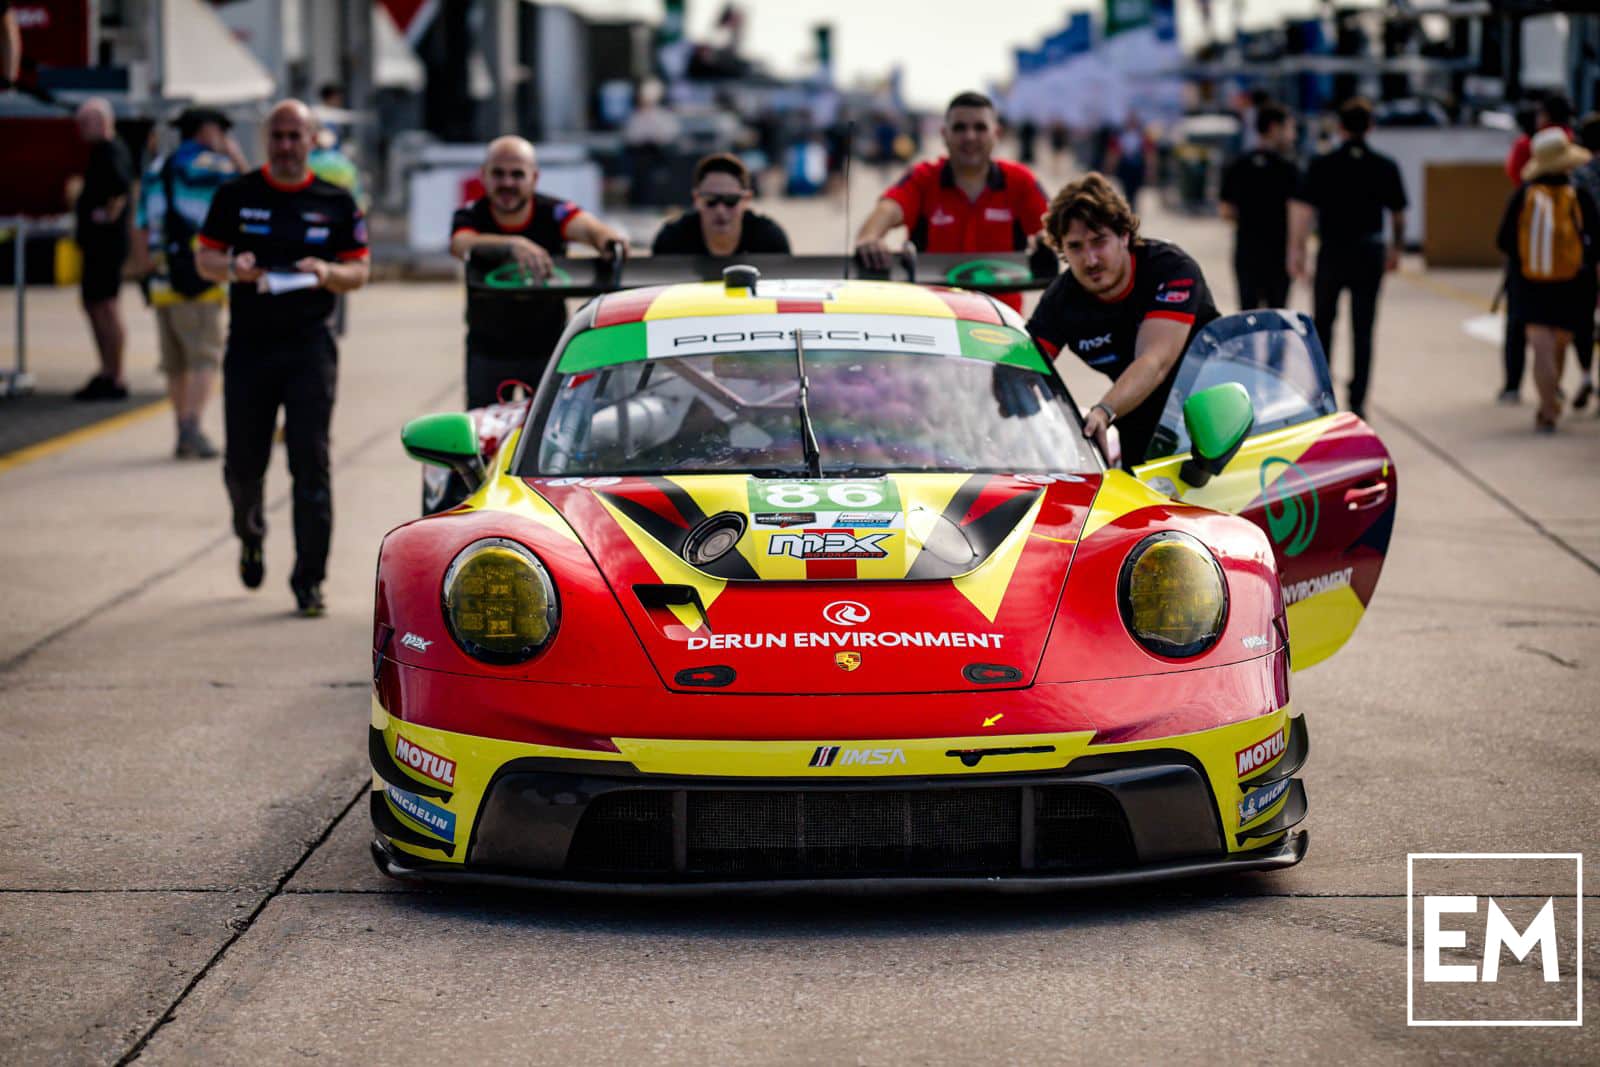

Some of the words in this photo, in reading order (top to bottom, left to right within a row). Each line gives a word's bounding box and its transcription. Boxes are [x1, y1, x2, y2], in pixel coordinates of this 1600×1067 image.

[674, 330, 936, 346] PORSCHE
[766, 484, 883, 508] 86
[1281, 567, 1353, 604] NVIRONMENT
[687, 633, 787, 650] DERUN
[794, 631, 1005, 649] ENVIRONMENT
[396, 737, 454, 783] MOTUL
[840, 748, 907, 766] IMSA
[1238, 731, 1285, 776] MOTUL
[390, 788, 449, 830] MICHELIN
